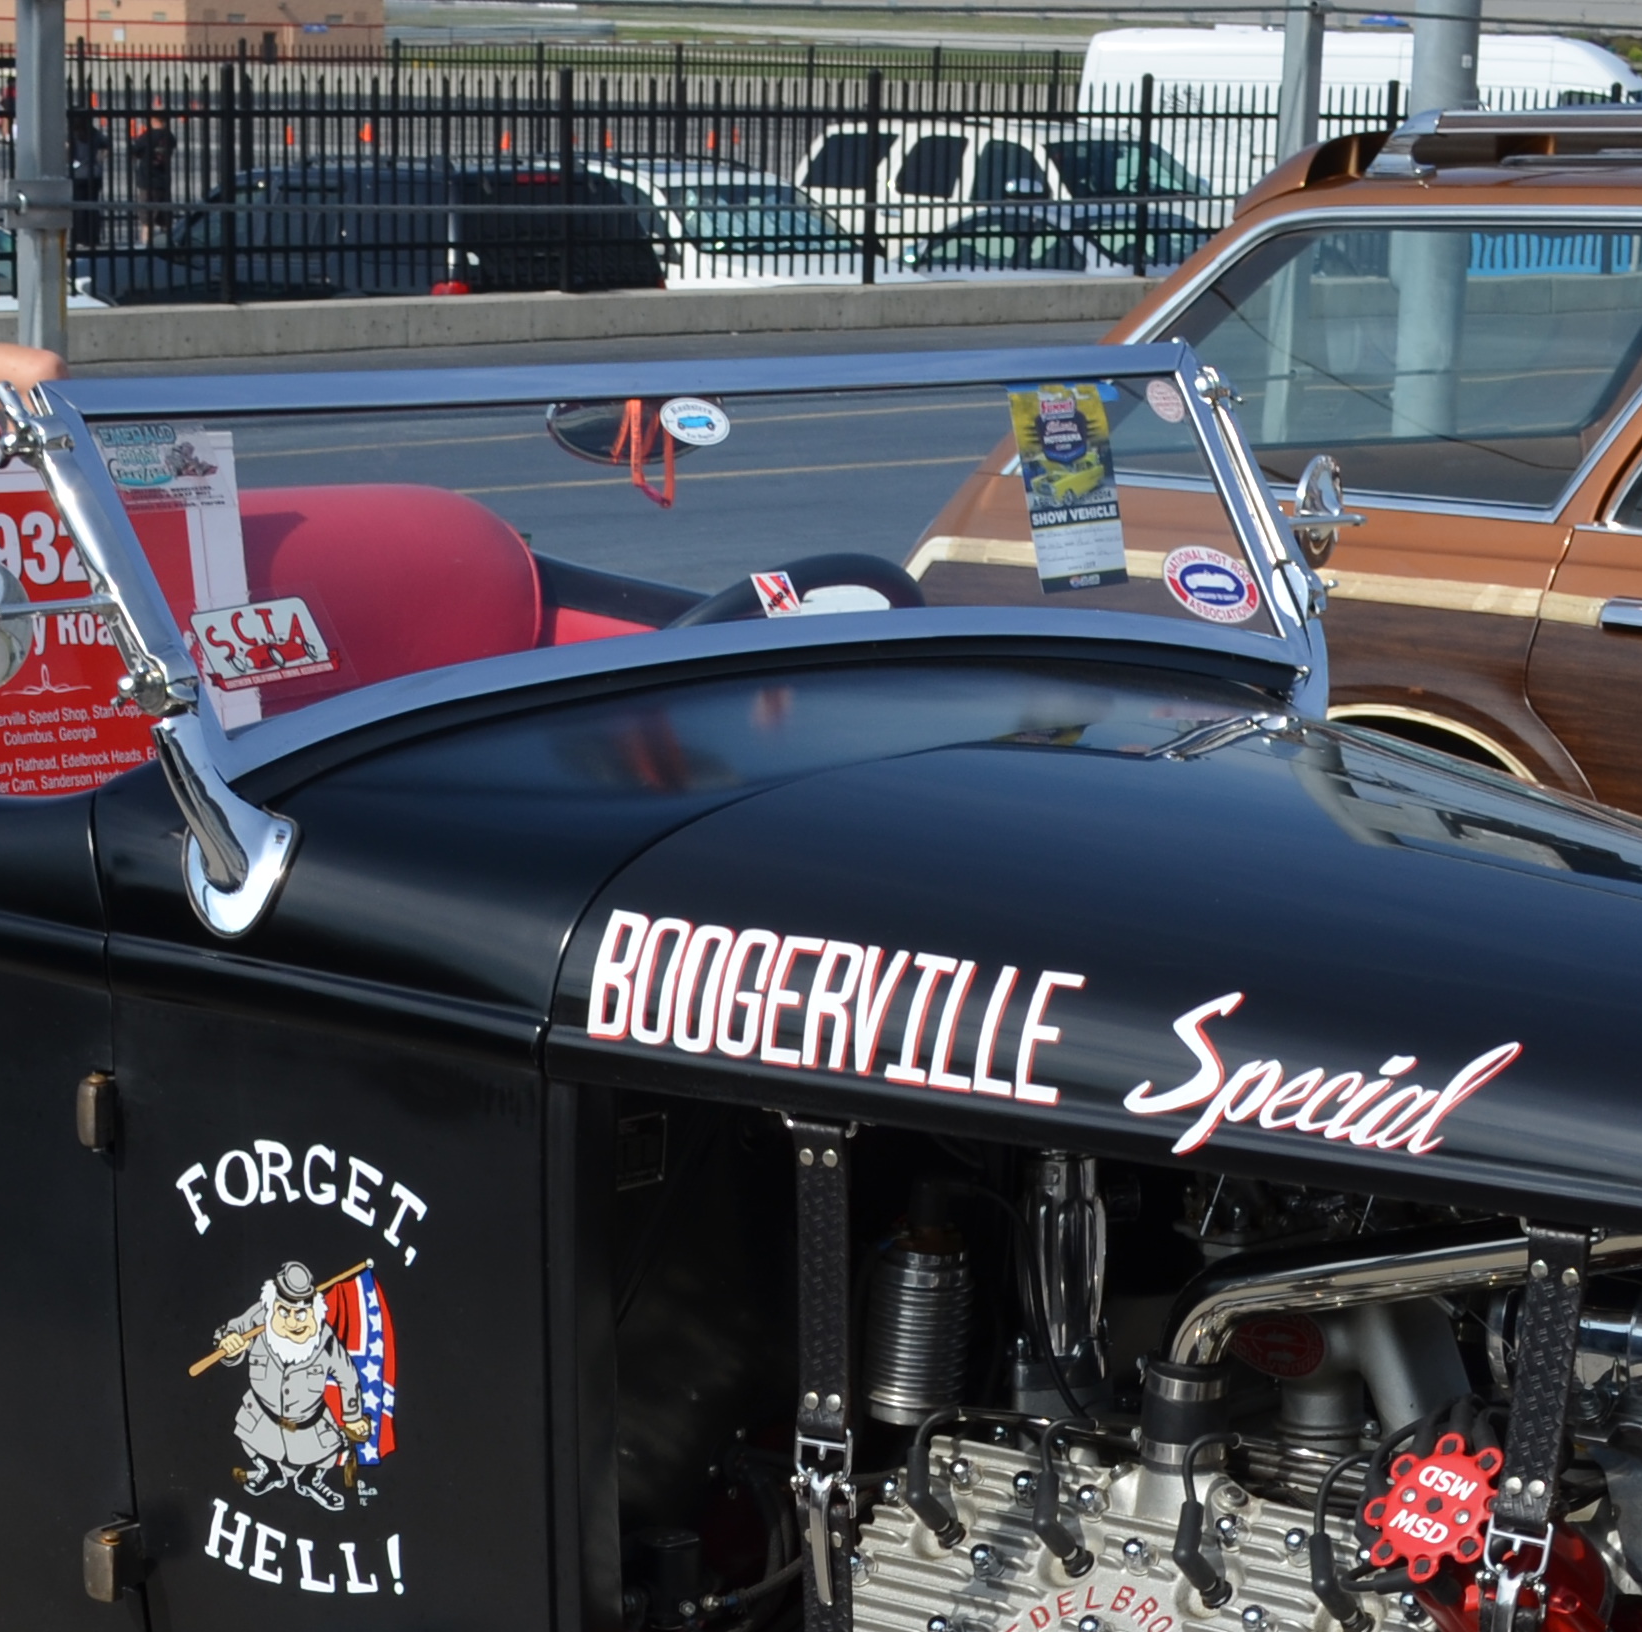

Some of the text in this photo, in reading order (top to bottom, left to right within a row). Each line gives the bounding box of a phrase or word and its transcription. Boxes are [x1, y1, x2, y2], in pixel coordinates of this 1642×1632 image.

[97, 422, 176, 447] EMERALD
[1031, 503, 1118, 527] SHOW VEHICLE
[1167, 549, 1252, 583] NATIONAL HOT ROD
[1189, 600, 1252, 621] ASSOCIATION
[28, 709, 59, 727] Speed
[60, 706, 90, 723] Shop,
[92, 705, 115, 719] Stan
[3, 726, 97, 746] Columbus, Georgia
[15, 756, 59, 773] Flathead,
[61, 751, 110, 769] Edelbrock
[111, 748, 145, 764] Heads,
[11, 777, 38, 793] Cam,
[40, 771, 93, 789] Sanderson
[585, 908, 1524, 1156] BOOGERVILLE Special
[175, 1138, 428, 1267] FORGET,
[1419, 1464, 1479, 1501] MSD
[1388, 1506, 1449, 1546] MSD
[204, 1497, 405, 1596] HELL!
